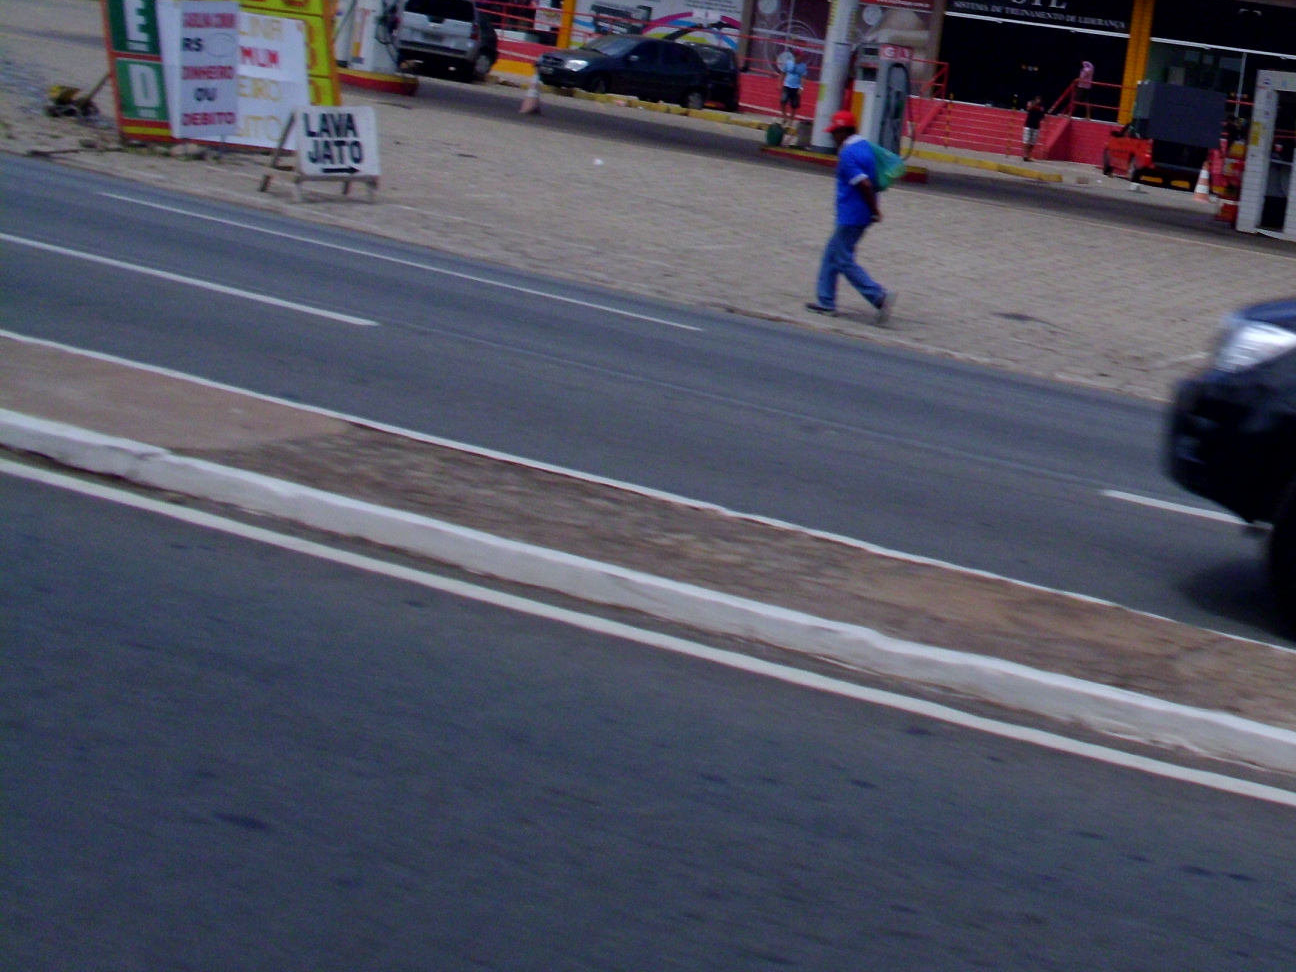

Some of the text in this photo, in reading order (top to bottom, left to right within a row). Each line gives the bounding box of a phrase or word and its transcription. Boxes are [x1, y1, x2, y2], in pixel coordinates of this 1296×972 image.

[128, 63, 159, 108] D
[302, 112, 359, 139] LAVA
[307, 139, 364, 165] JATO
